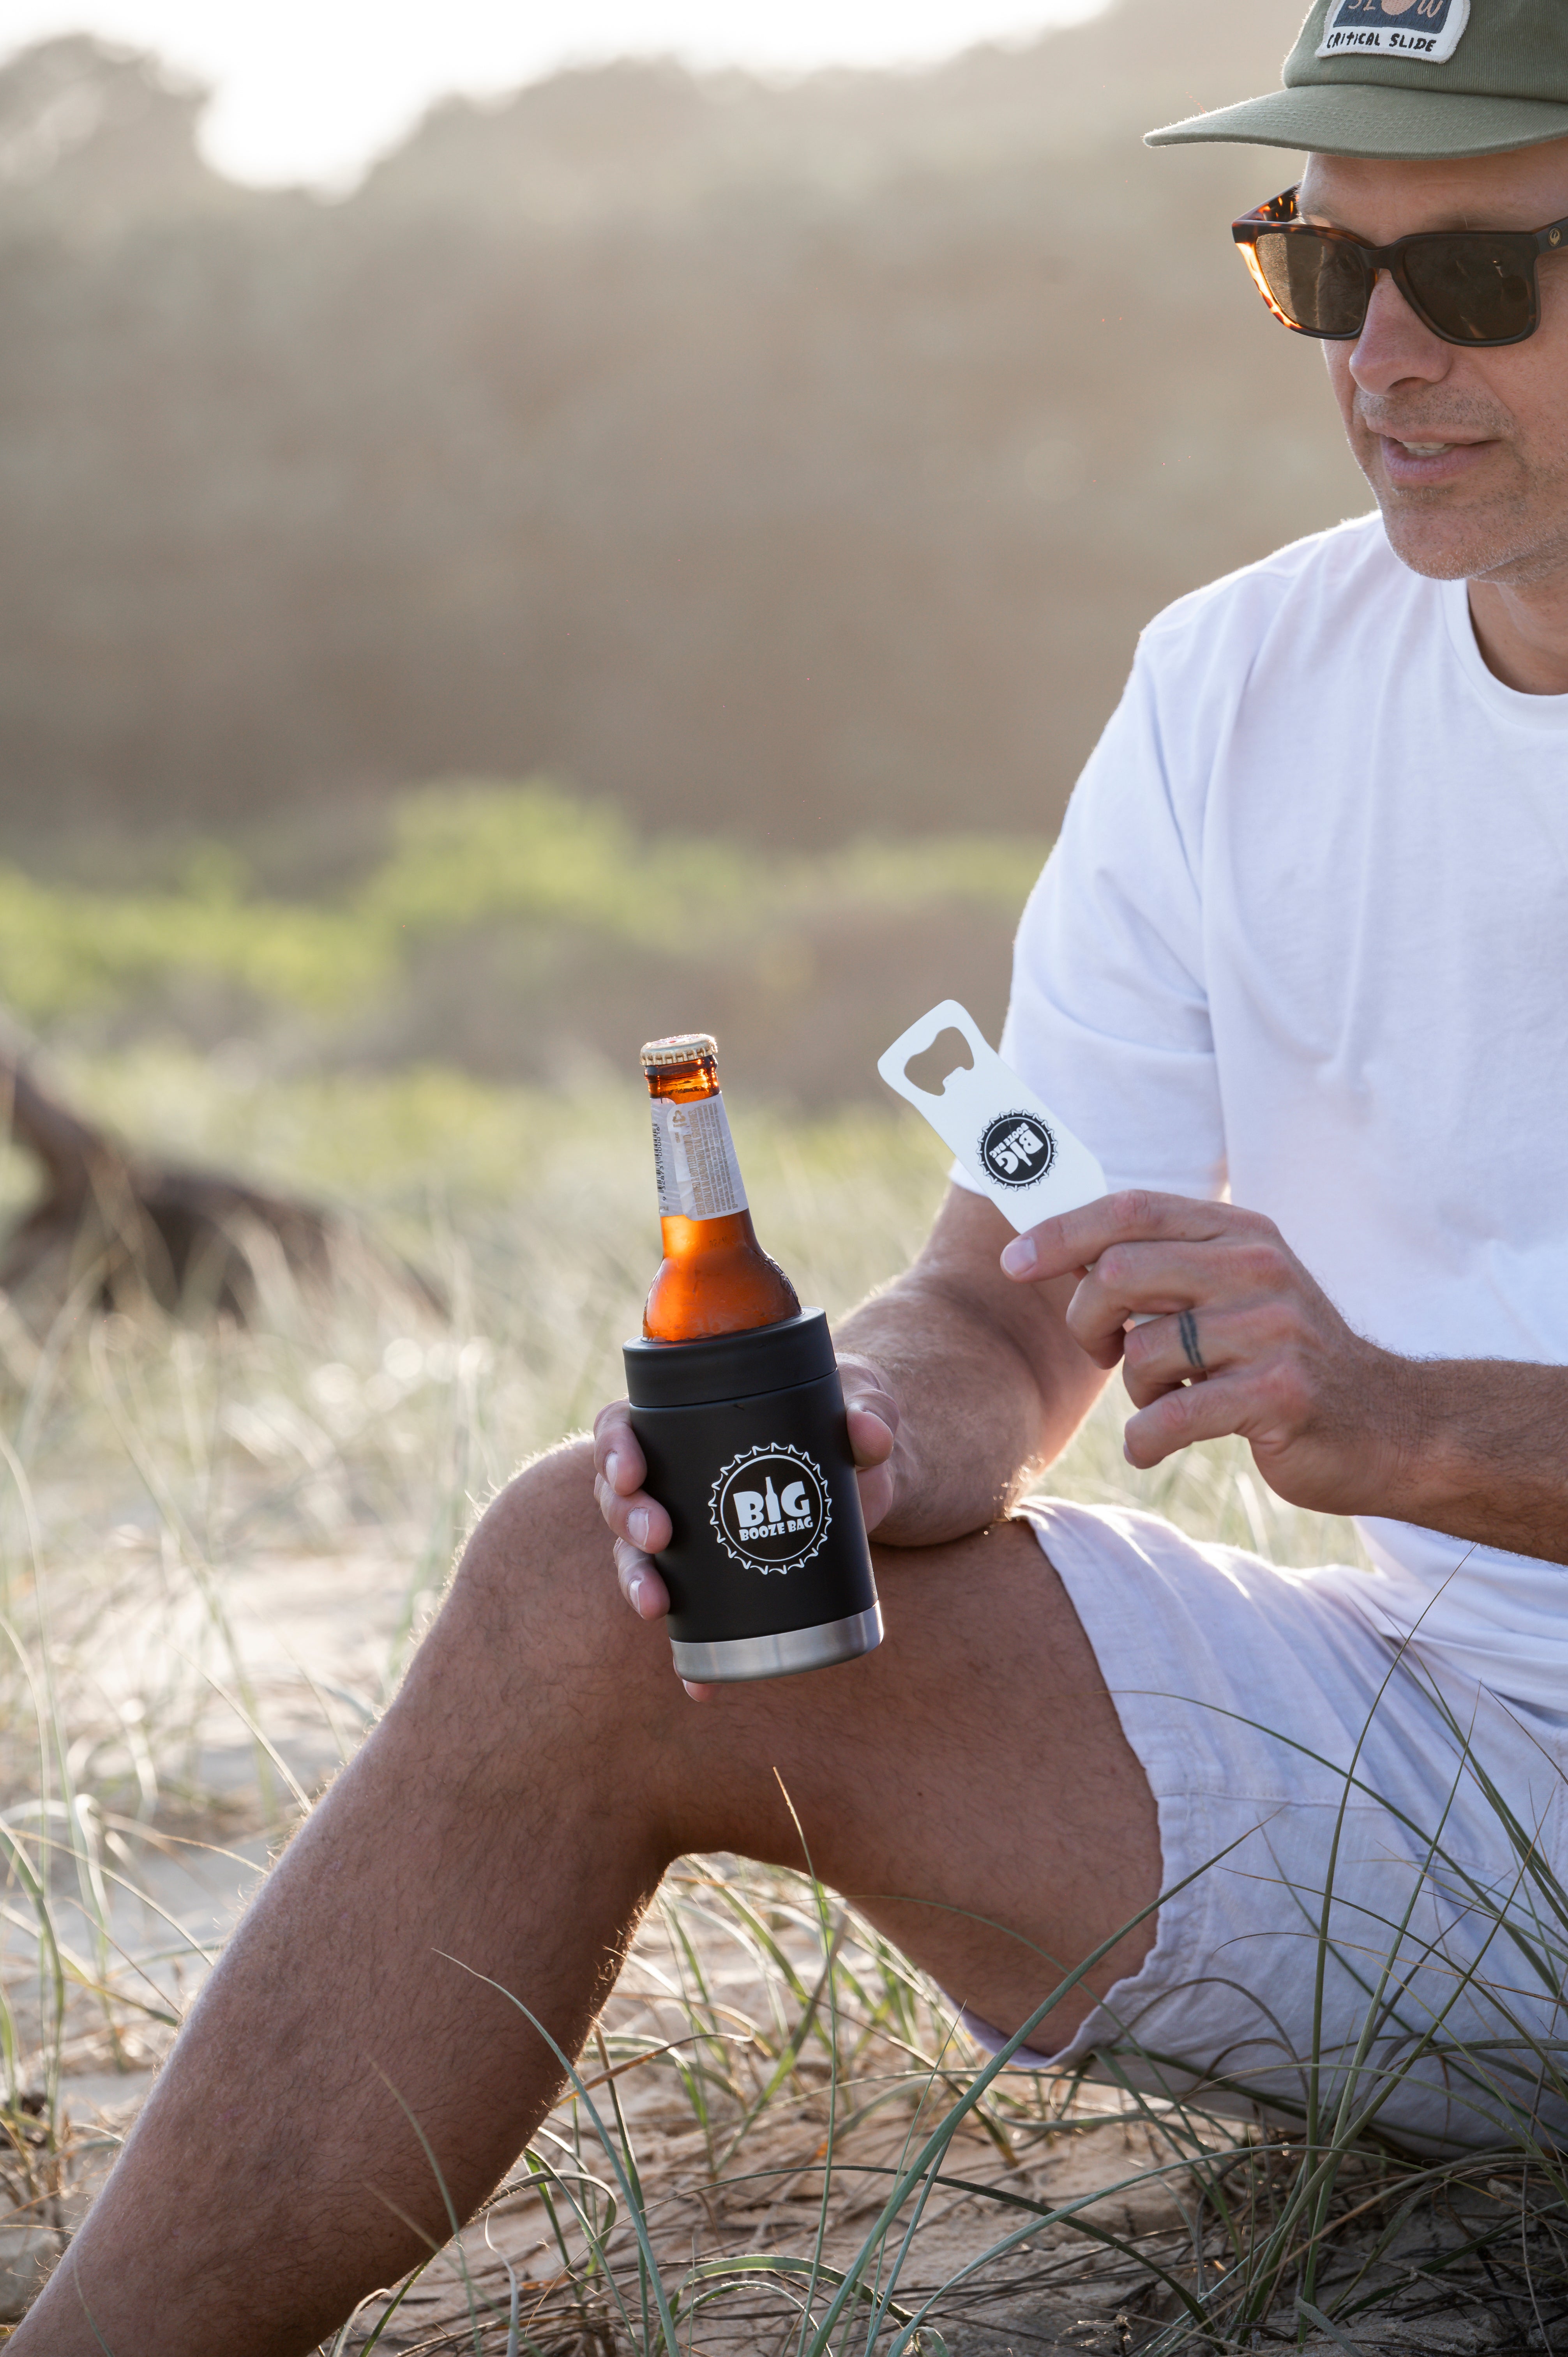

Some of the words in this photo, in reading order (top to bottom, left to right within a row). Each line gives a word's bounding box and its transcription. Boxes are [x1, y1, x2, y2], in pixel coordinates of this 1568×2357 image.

[1327, 32, 1380, 48] CRITICAL
[1389, 33, 1436, 52] SLIDE
[682, 1134, 695, 1155] AROUND
[1003, 1122, 1029, 1147] BOOZE
[693, 1137, 705, 1160] NEUTRAL
[989, 1142, 1006, 1159] BAG
[995, 1129, 1044, 1174] BIG
[686, 1155, 699, 1177] BOTTLED
[697, 1160, 709, 1181] CARBON
[691, 1182, 703, 1203] BREWED
[702, 1186, 715, 1214] AUSTRALIA
[695, 1202, 706, 1216] BEER
[733, 1477, 810, 1527] BIG
[739, 1522, 786, 1541] BOOZE
[787, 1516, 813, 1532] BAG
